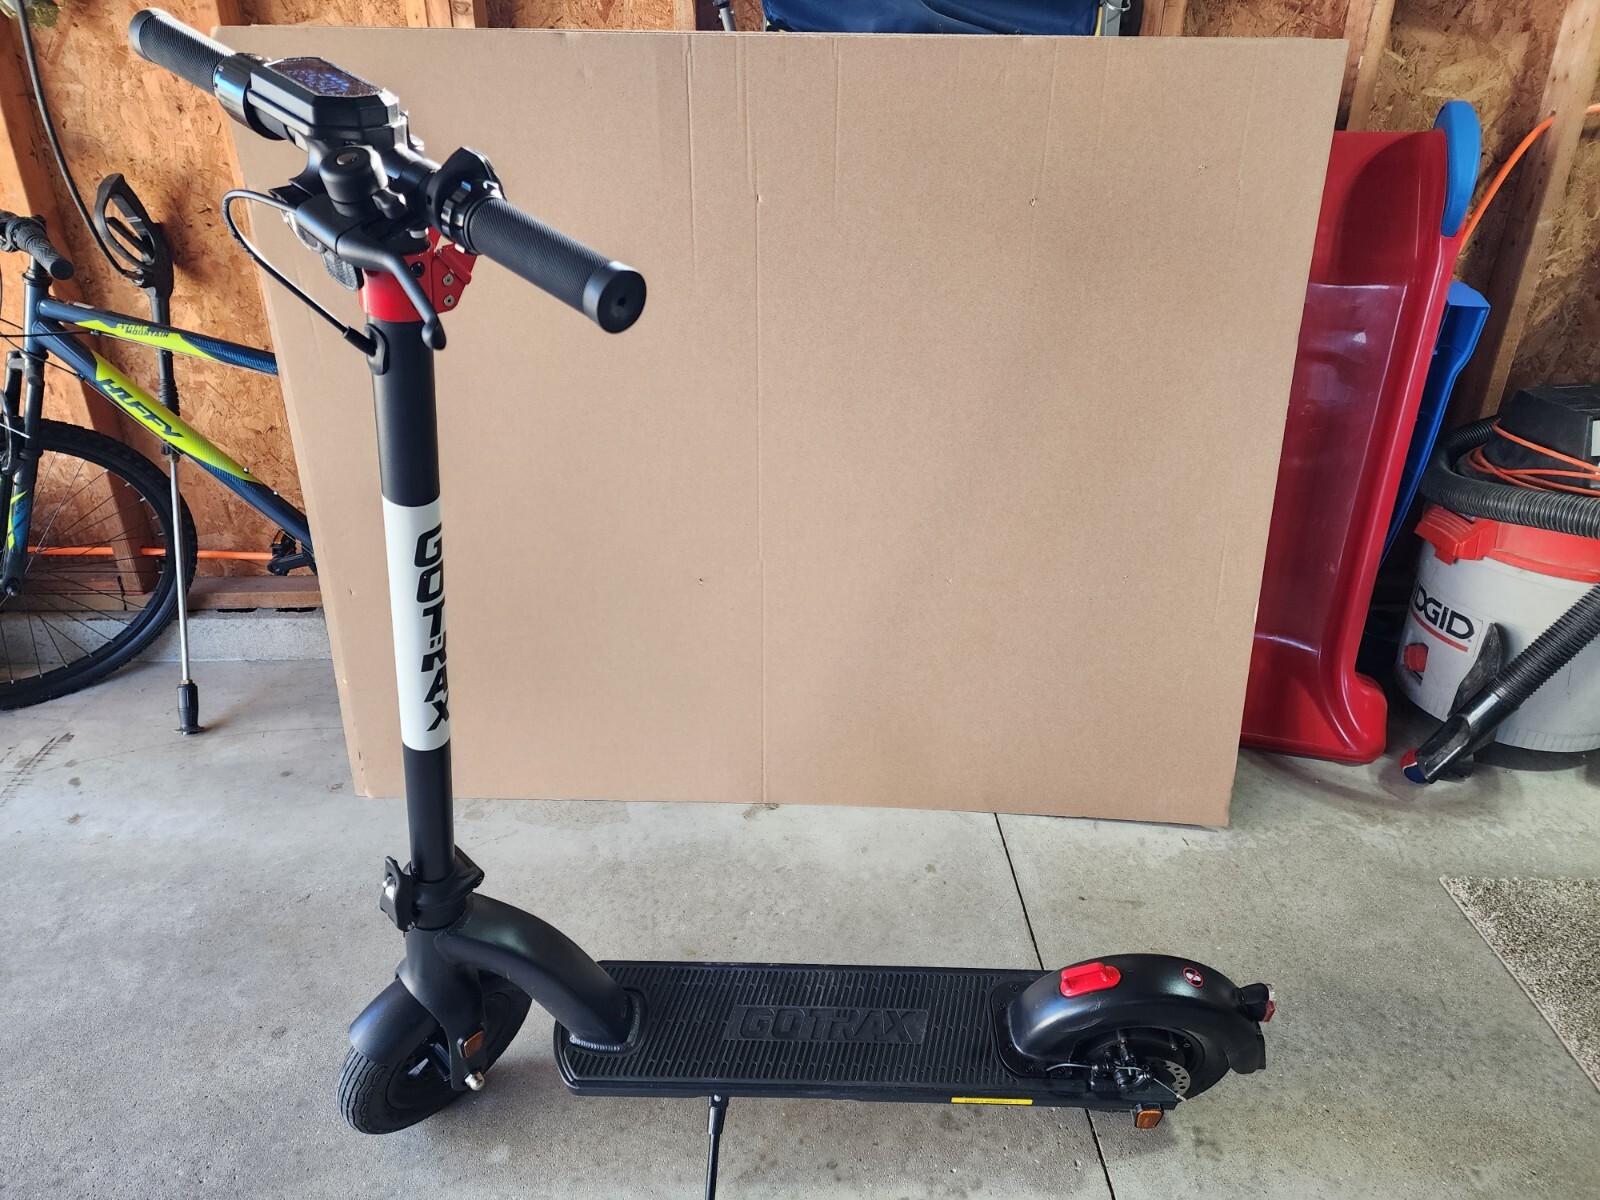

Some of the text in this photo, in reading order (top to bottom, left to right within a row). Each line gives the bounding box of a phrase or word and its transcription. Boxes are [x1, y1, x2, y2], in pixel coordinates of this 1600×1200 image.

[125, 328, 170, 338] MOUNTAIN
[97, 378, 184, 438] HUFFY
[414, 522, 450, 732] GOTRAX
[1412, 580, 1475, 640] IDGID
[739, 1007, 915, 1043] GOTRAX
